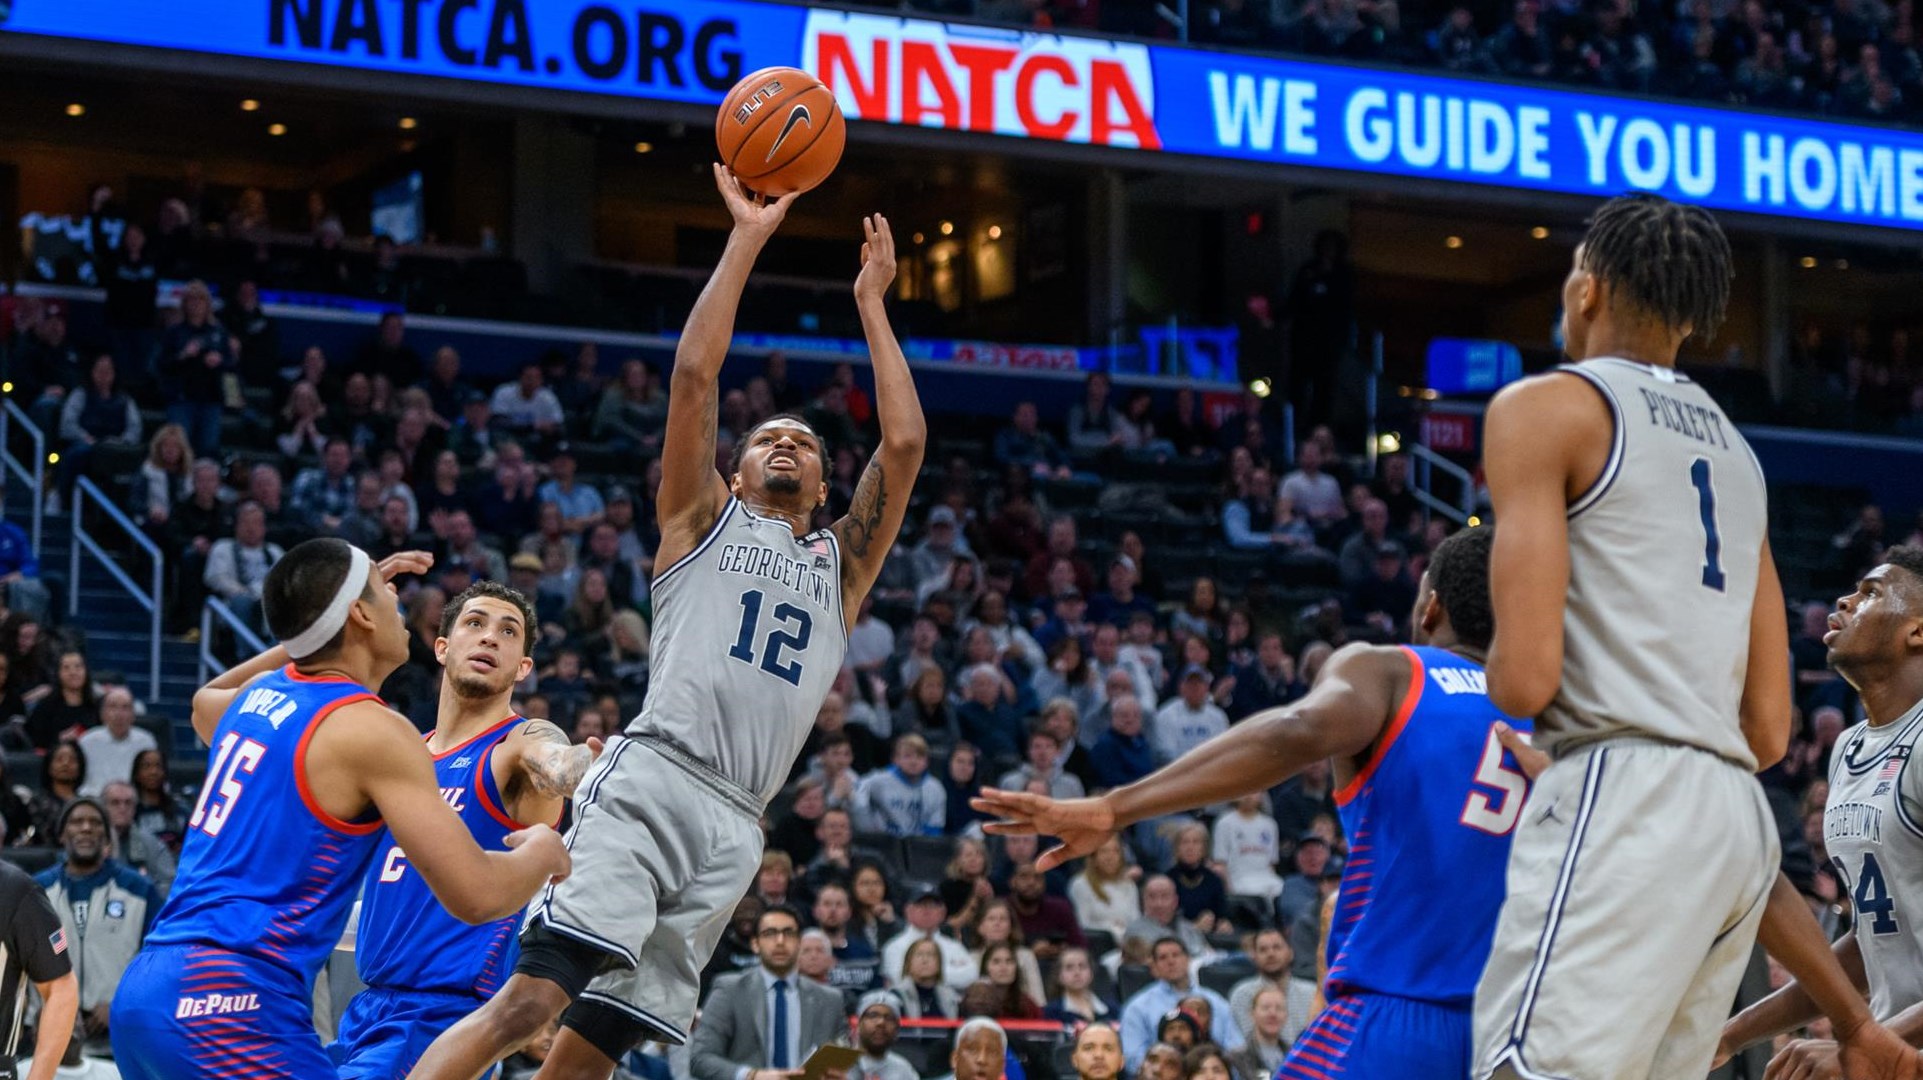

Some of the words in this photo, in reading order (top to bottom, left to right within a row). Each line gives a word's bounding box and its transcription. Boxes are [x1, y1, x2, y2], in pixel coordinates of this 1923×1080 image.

[268, 0, 744, 90] NATCA.ORG
[817, 33, 1162, 150] NATCA
[1208, 72, 1317, 155] WE
[1345, 87, 1551, 179] GUIDE
[1577, 112, 1716, 196] YOU
[1744, 131, 1923, 222] HOME
[1639, 387, 1729, 450] PICKETT
[1690, 457, 1726, 593] 1
[728, 588, 814, 688] 12
[189, 731, 268, 838] 15
[1459, 719, 1533, 838] 5
